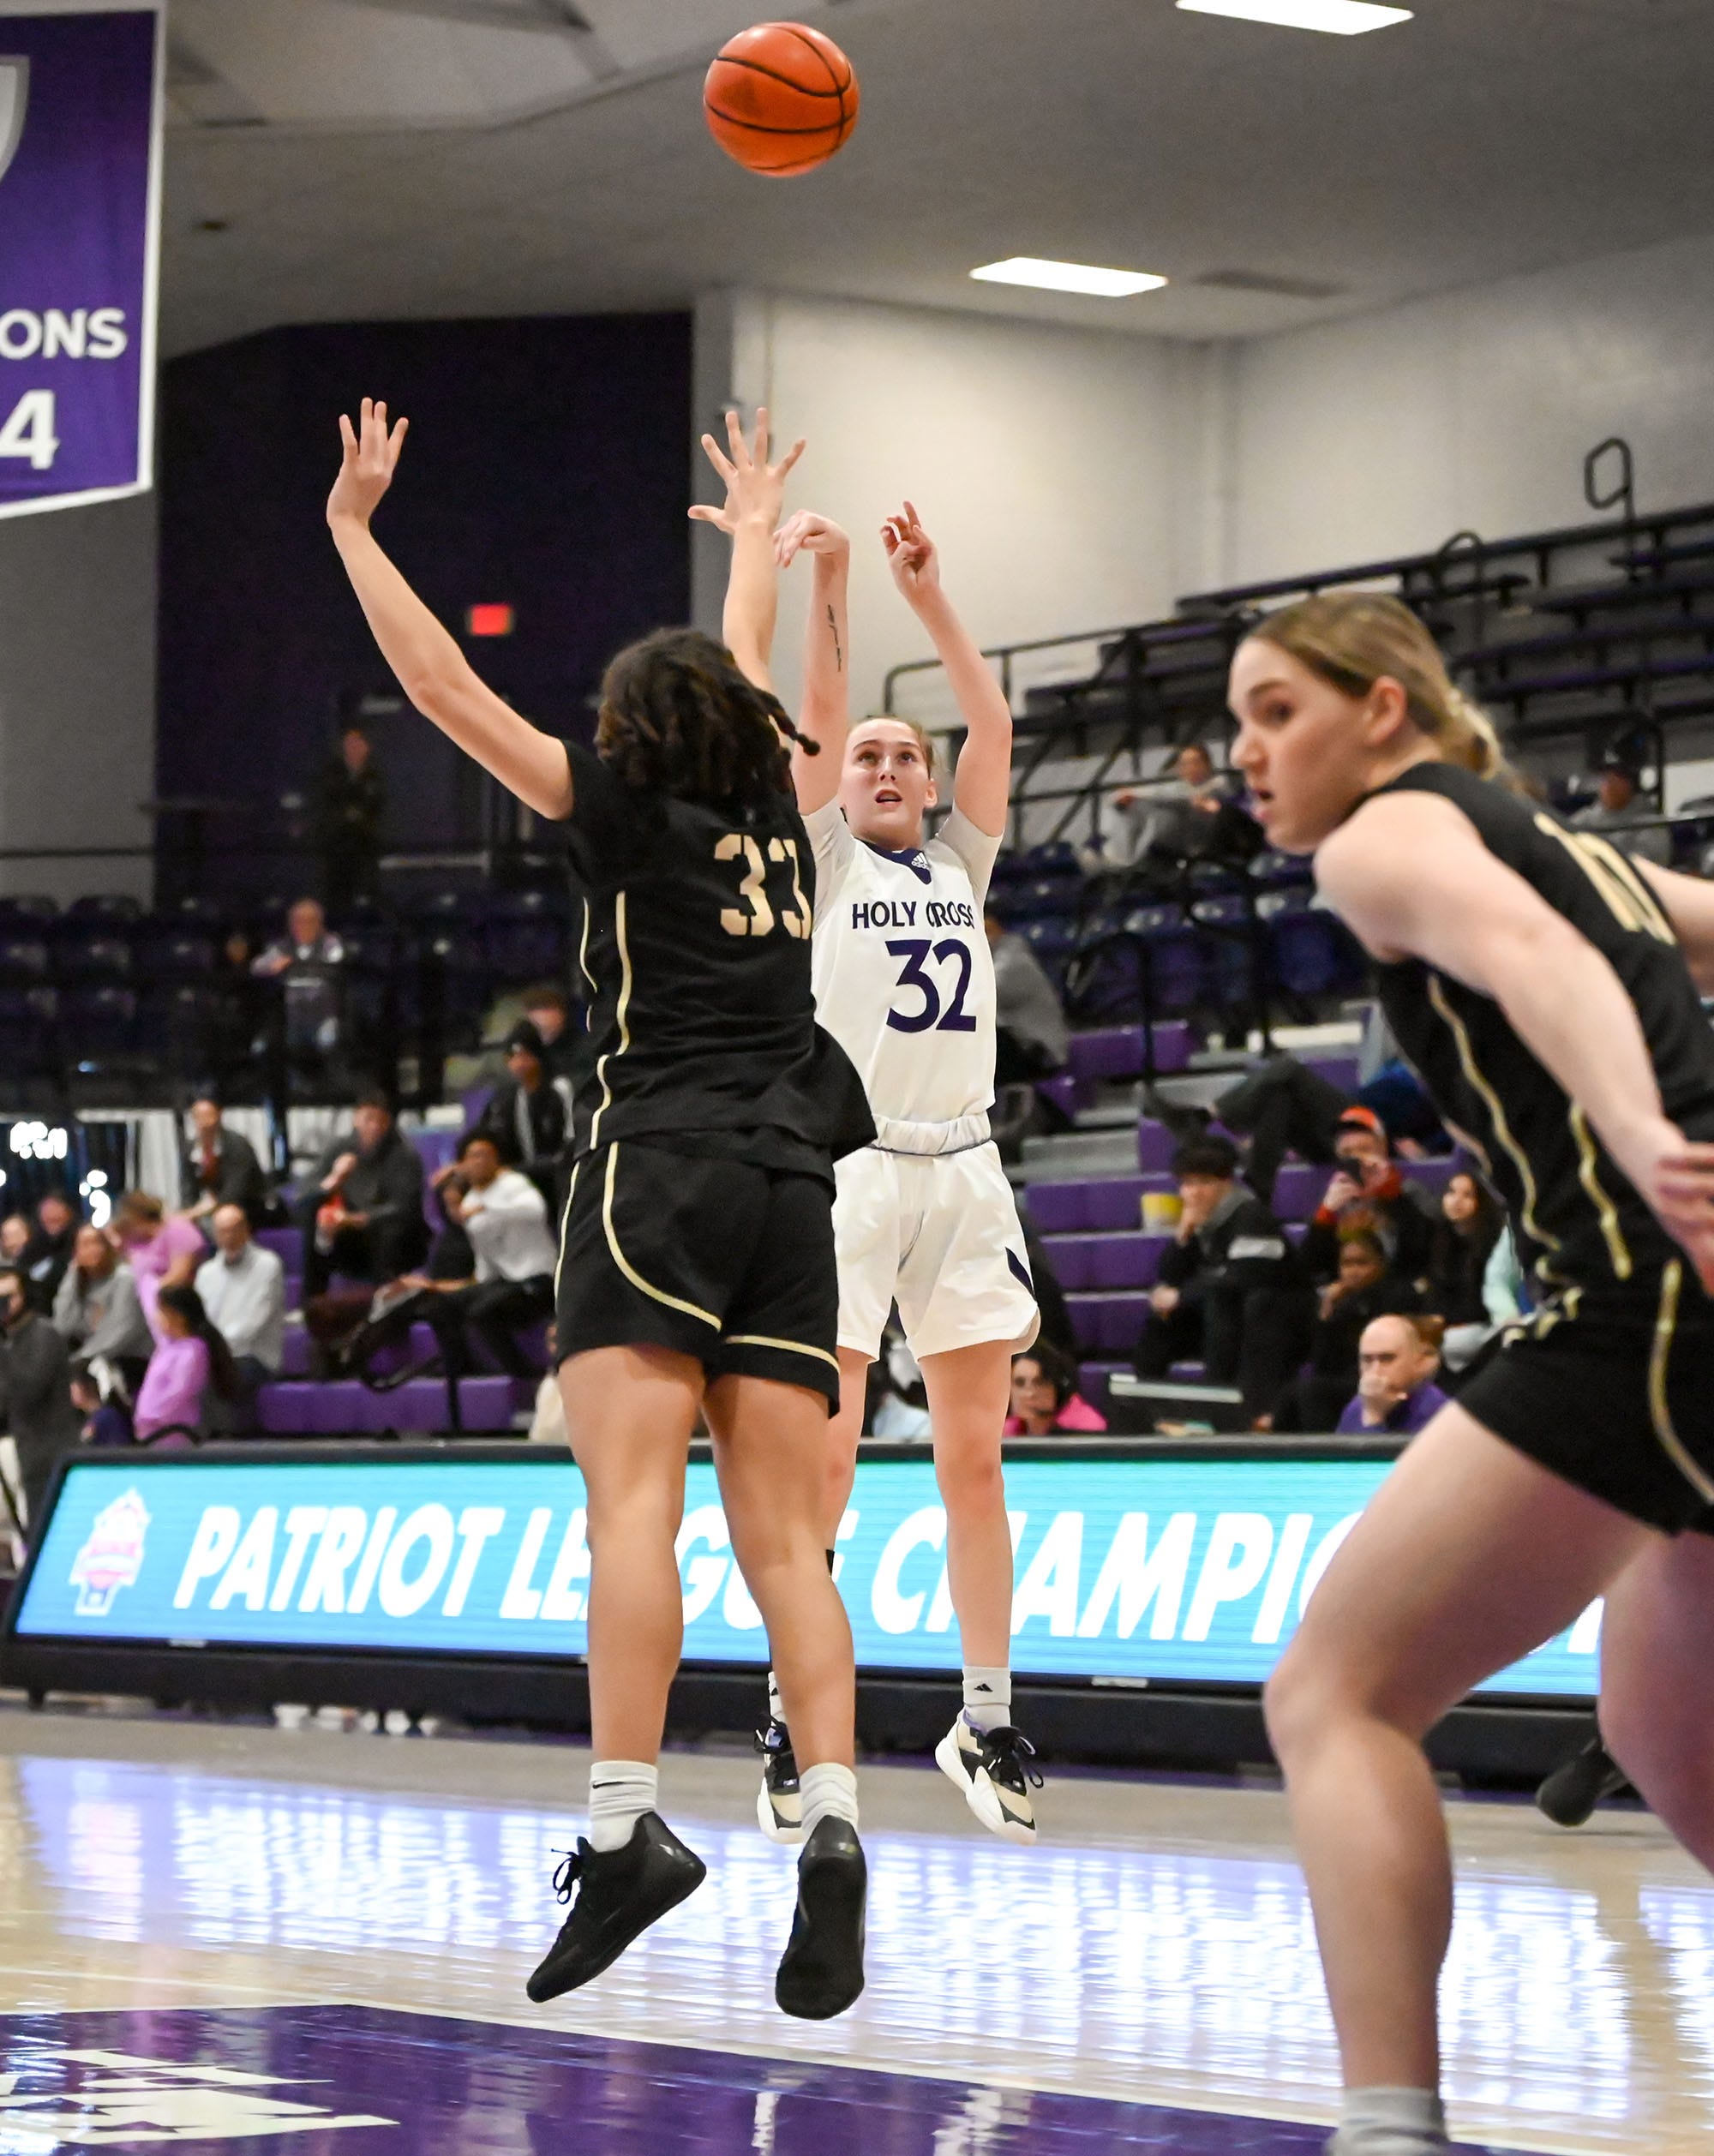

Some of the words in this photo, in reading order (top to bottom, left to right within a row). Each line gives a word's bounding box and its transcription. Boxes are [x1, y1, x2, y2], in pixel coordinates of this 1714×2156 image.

[0, 308, 127, 360] ONS
[714, 834, 812, 940] 33
[852, 901, 916, 929] HOLY
[885, 939, 976, 1033] 32
[173, 1503, 506, 1617] PATRIOT
[500, 1505, 860, 1629] LEG
[871, 1506, 1366, 1644] CAMPI
